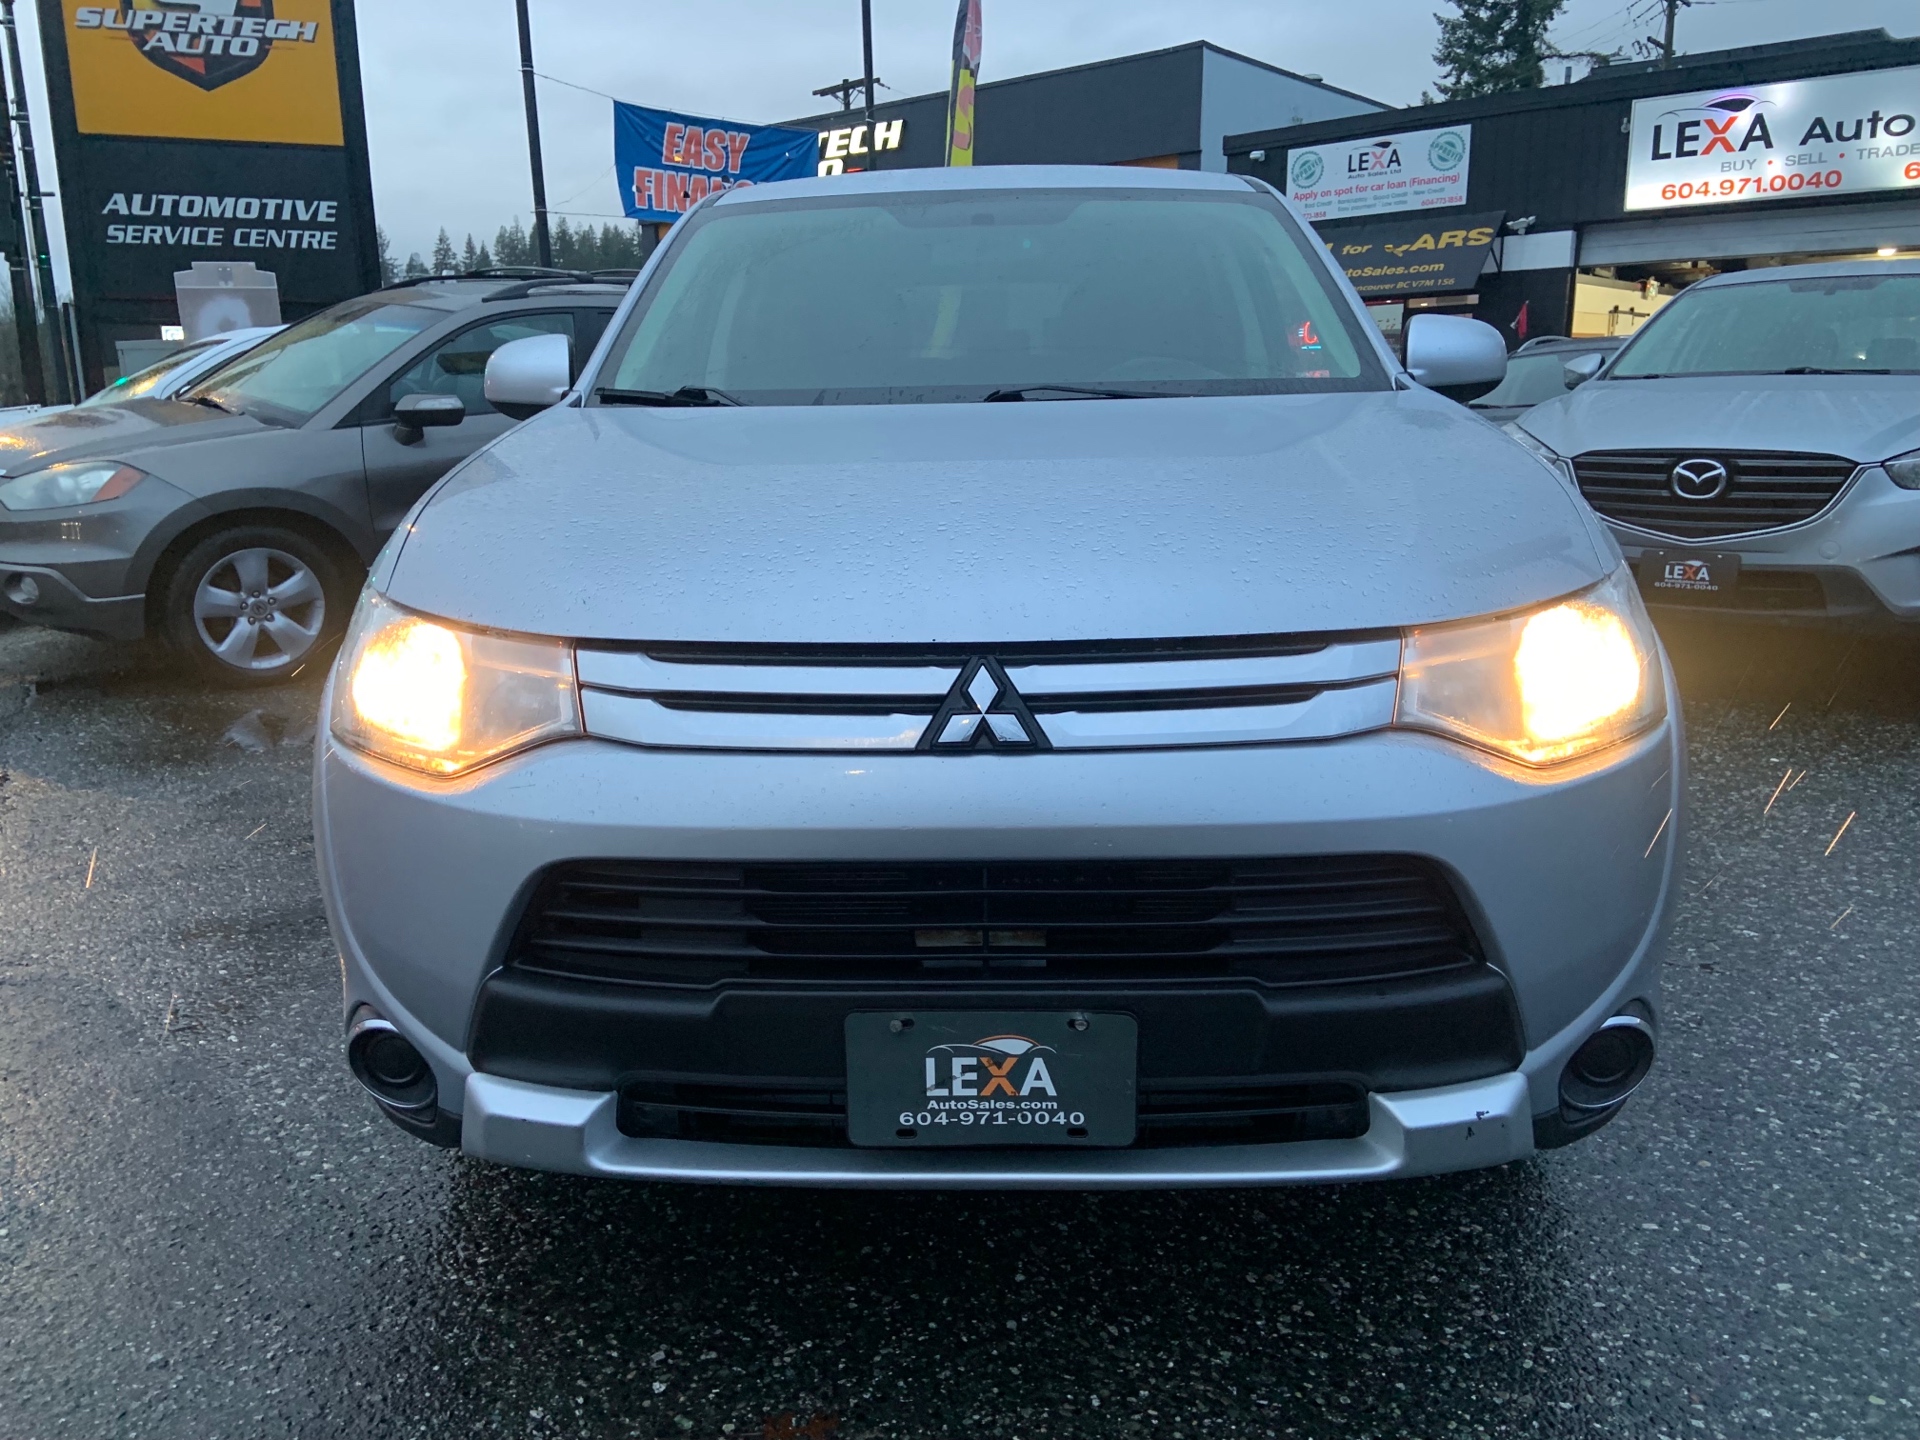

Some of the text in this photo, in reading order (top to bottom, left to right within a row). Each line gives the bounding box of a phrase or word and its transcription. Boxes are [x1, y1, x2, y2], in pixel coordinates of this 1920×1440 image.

[75, 7, 318, 41] SUPERTECH
[143, 32, 259, 57] AUTO
[662, 121, 750, 174] EASY
[1651, 110, 1916, 161] LEXA Auto
[1347, 149, 1402, 173] LEXA
[1720, 143, 1920, 173] BUY SELL TRADE
[1293, 174, 1460, 202] Apply on spot for car loan (Financing)
[1347, 172, 1365, 180] Auto
[1661, 169, 1843, 201] 604.971.0040
[102, 193, 338, 223] AUTOMOTIVE
[106, 225, 338, 250] SERVICE CENTRE
[1342, 244, 1373, 255] for
[1396, 281, 1410, 289] BC
[1411, 279, 1435, 287] V7M
[1664, 564, 1710, 581] LEXA
[925, 1057, 1058, 1096] LEXA
[926, 1100, 1058, 1110] AutoSales.com
[899, 1111, 1085, 1126] 604-971-0040
